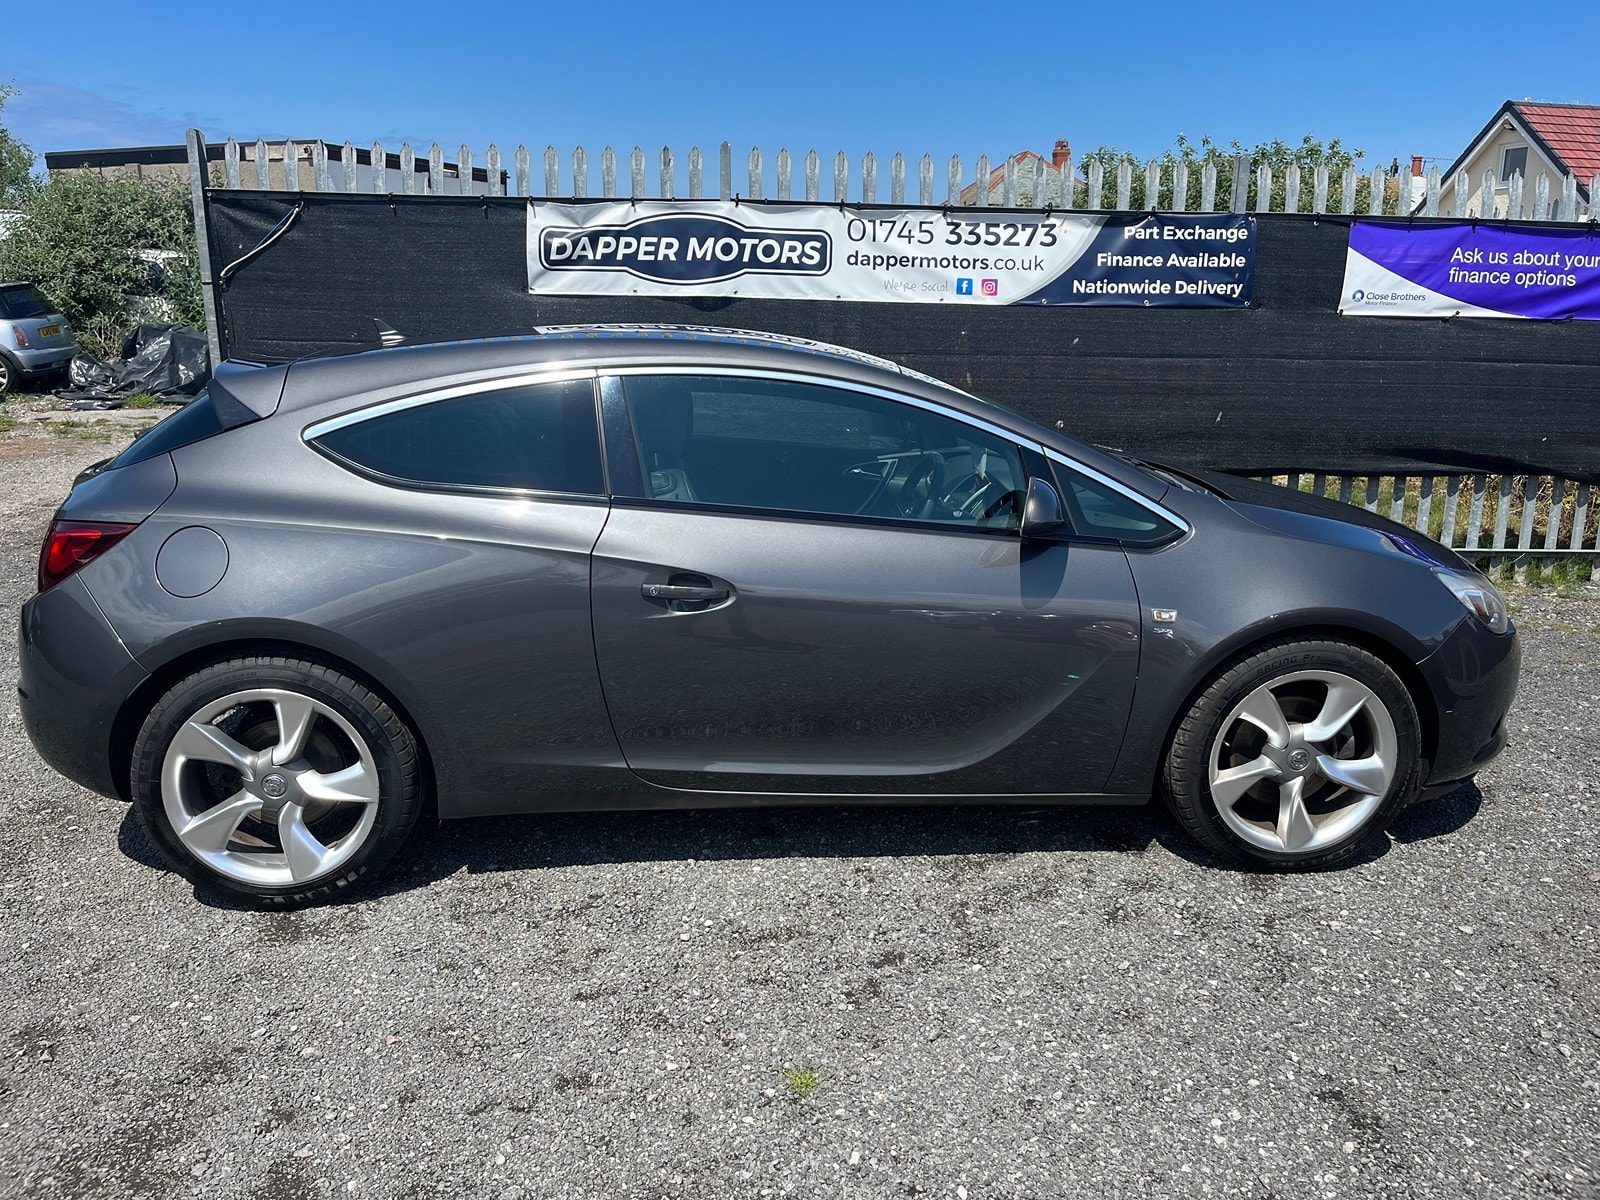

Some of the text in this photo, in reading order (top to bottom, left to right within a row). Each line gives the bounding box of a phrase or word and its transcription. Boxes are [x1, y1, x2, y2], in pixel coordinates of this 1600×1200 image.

[847, 218, 1057, 247] 01745 335273
[1124, 225, 1248, 243] Part Exchange
[549, 236, 822, 265] DAPPER MOTORS
[846, 250, 1045, 271] dappermotors.co.uk
[1097, 252, 1246, 268] Finance Available
[1450, 247, 1600, 271] Ask us about your
[884, 278, 949, 292] We're Social
[1449, 266, 1577, 289] finance options
[1072, 279, 1243, 298] Nationwide Delivery
[1366, 291, 1427, 302] Close Brothers
